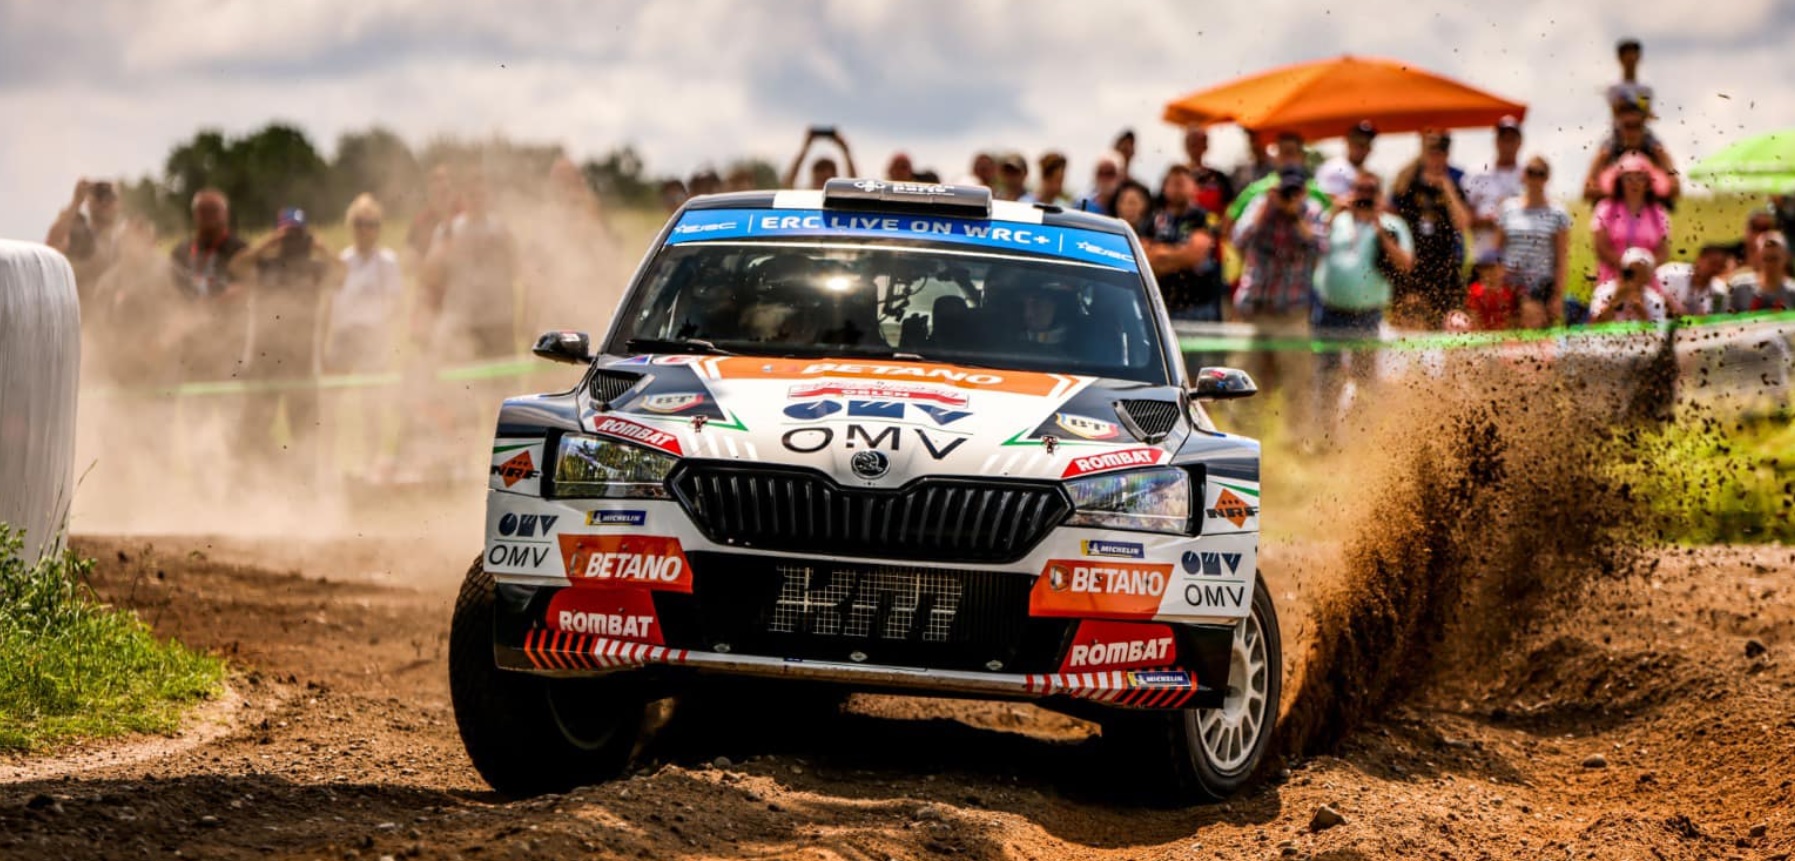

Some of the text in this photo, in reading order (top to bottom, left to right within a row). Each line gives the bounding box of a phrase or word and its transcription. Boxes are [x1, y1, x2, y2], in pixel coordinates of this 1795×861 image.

[761, 216, 1050, 245] ERC LIVE ON WRC+
[802, 363, 1003, 384] BETANO
[599, 420, 672, 446] ROMBAT
[781, 424, 968, 460] OMV
[1077, 450, 1152, 472] ROMBAT
[488, 544, 550, 569] OMV
[1100, 545, 1140, 554] MICHELIN
[584, 552, 683, 582] BETANO
[1071, 567, 1164, 596] BETANO
[1185, 584, 1245, 608] OMV
[559, 610, 653, 638] ROMBAT
[1070, 637, 1173, 666] ROMBAT
